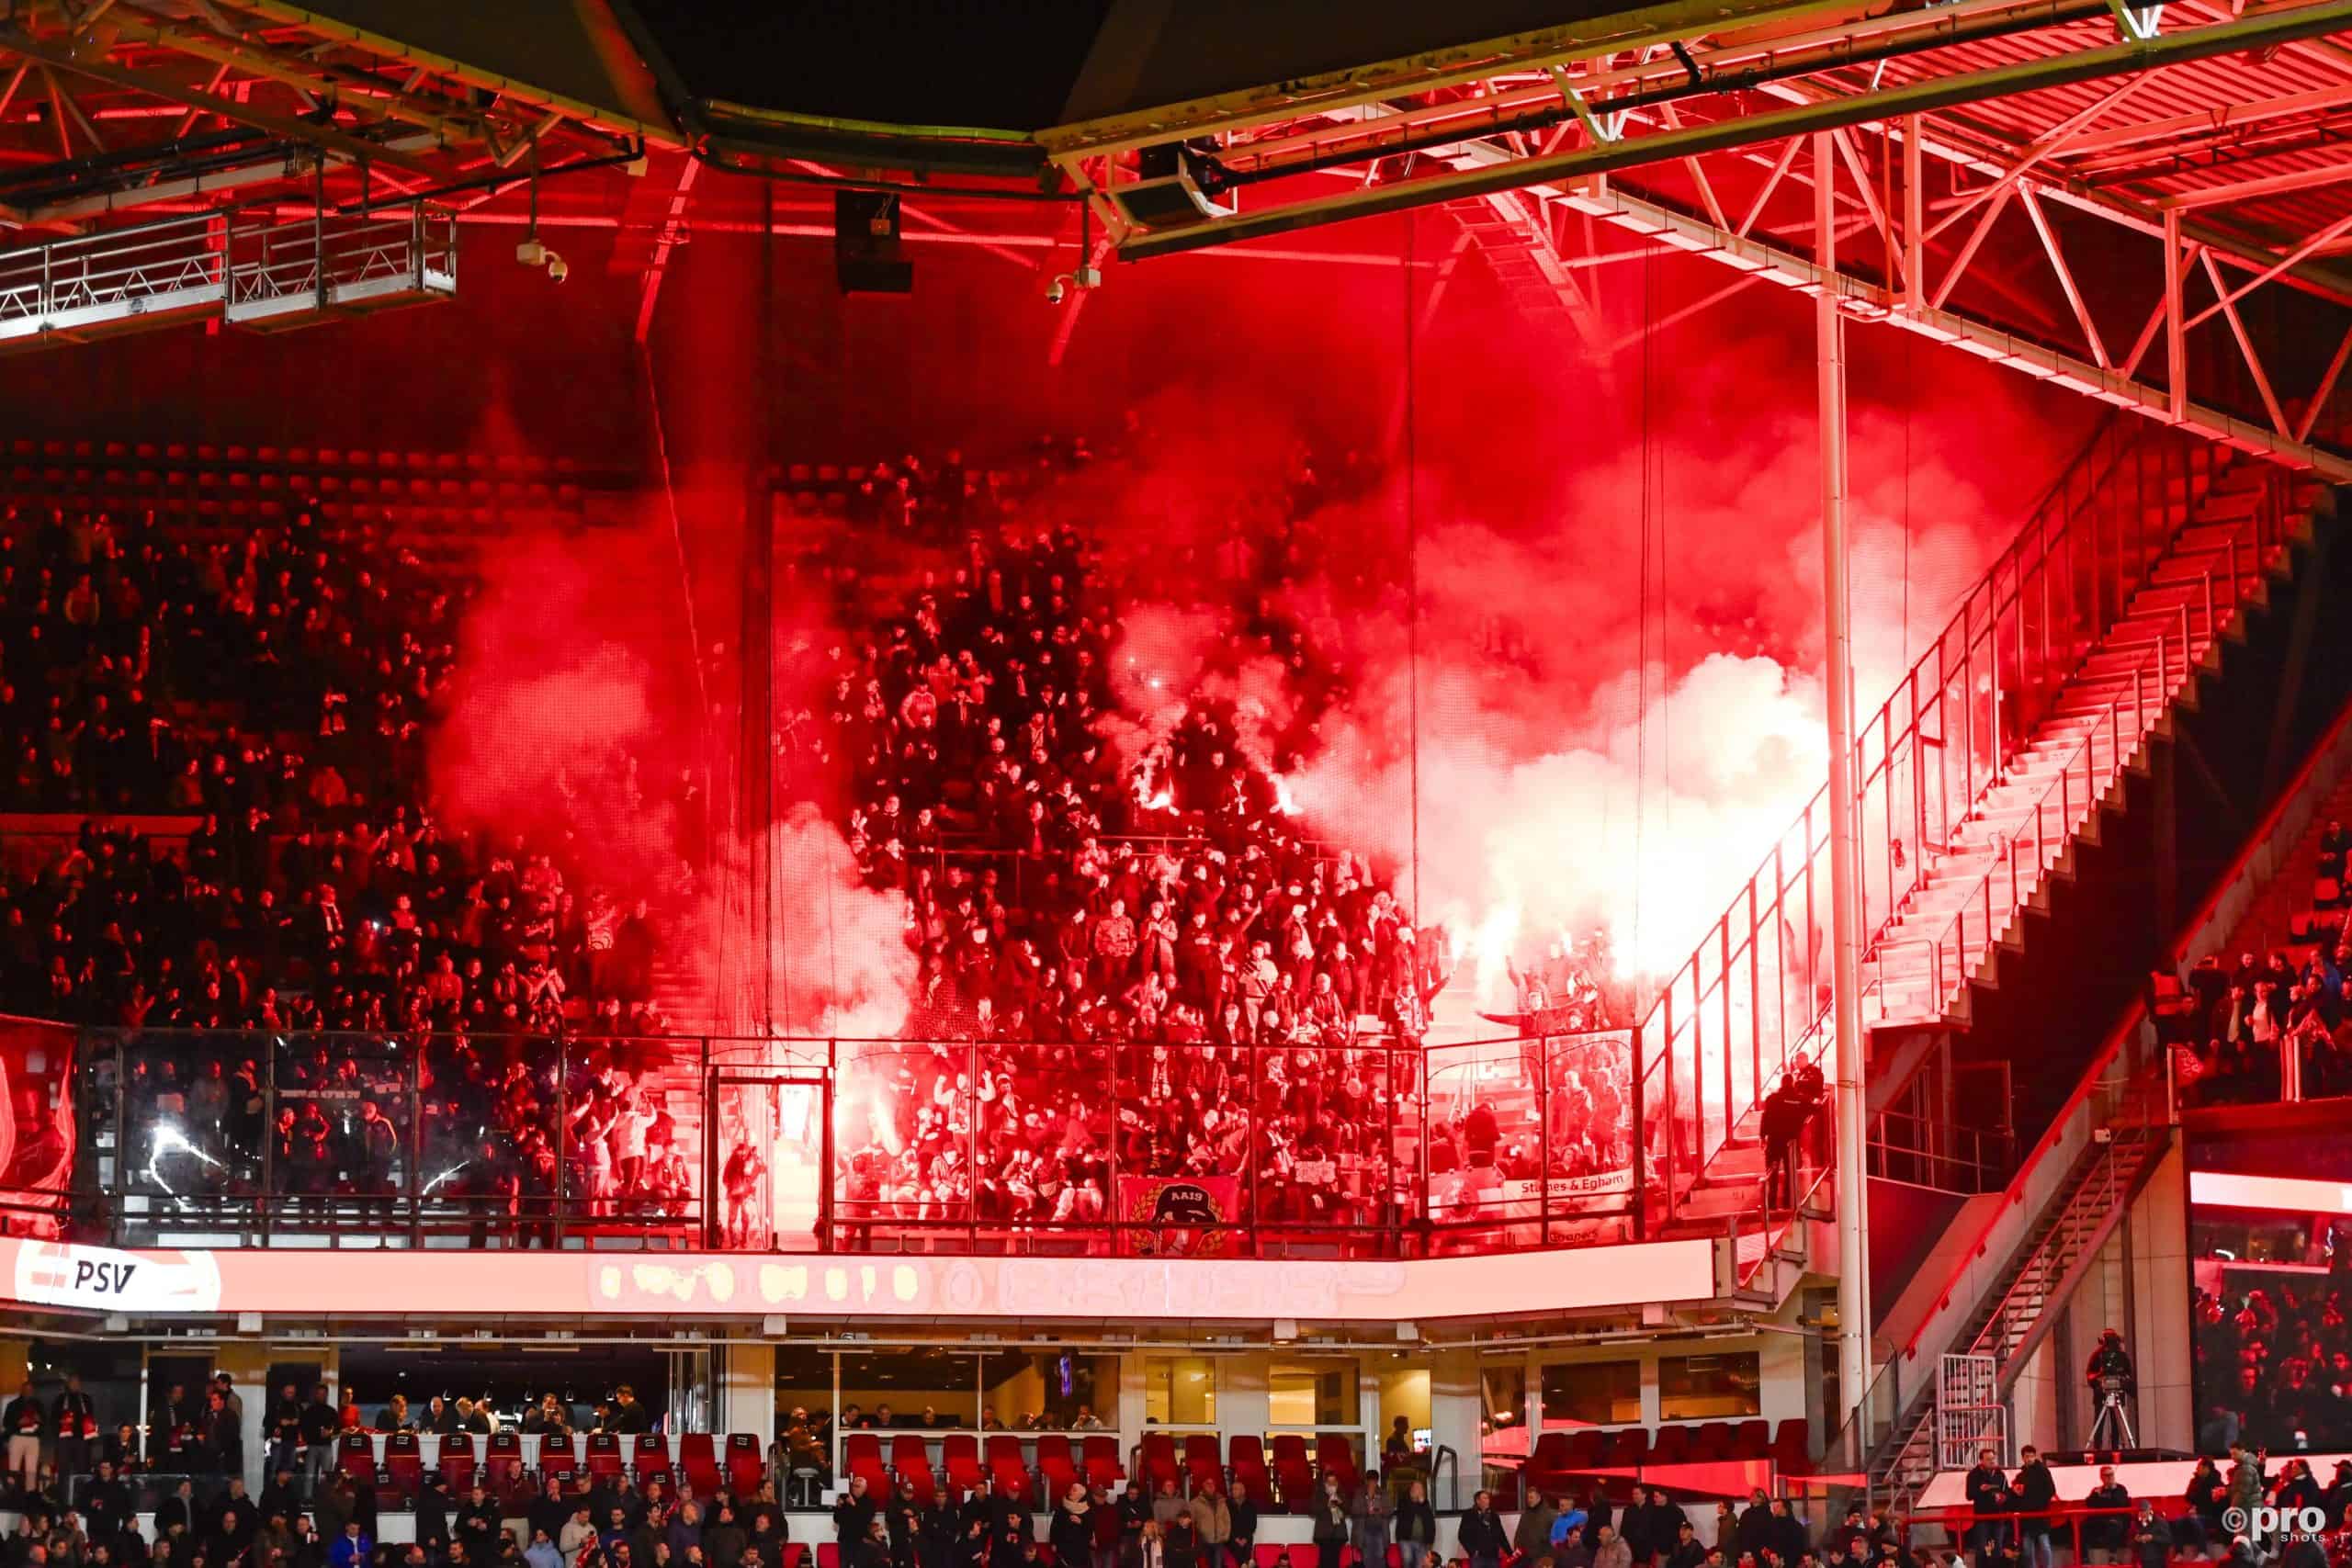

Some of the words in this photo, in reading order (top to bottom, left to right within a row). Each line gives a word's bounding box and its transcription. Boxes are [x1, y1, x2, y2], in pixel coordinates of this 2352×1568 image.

[1569, 1179, 1579, 1191] &
[1582, 1175, 1624, 1191] Egham
[74, 1259, 136, 1294] PSV
